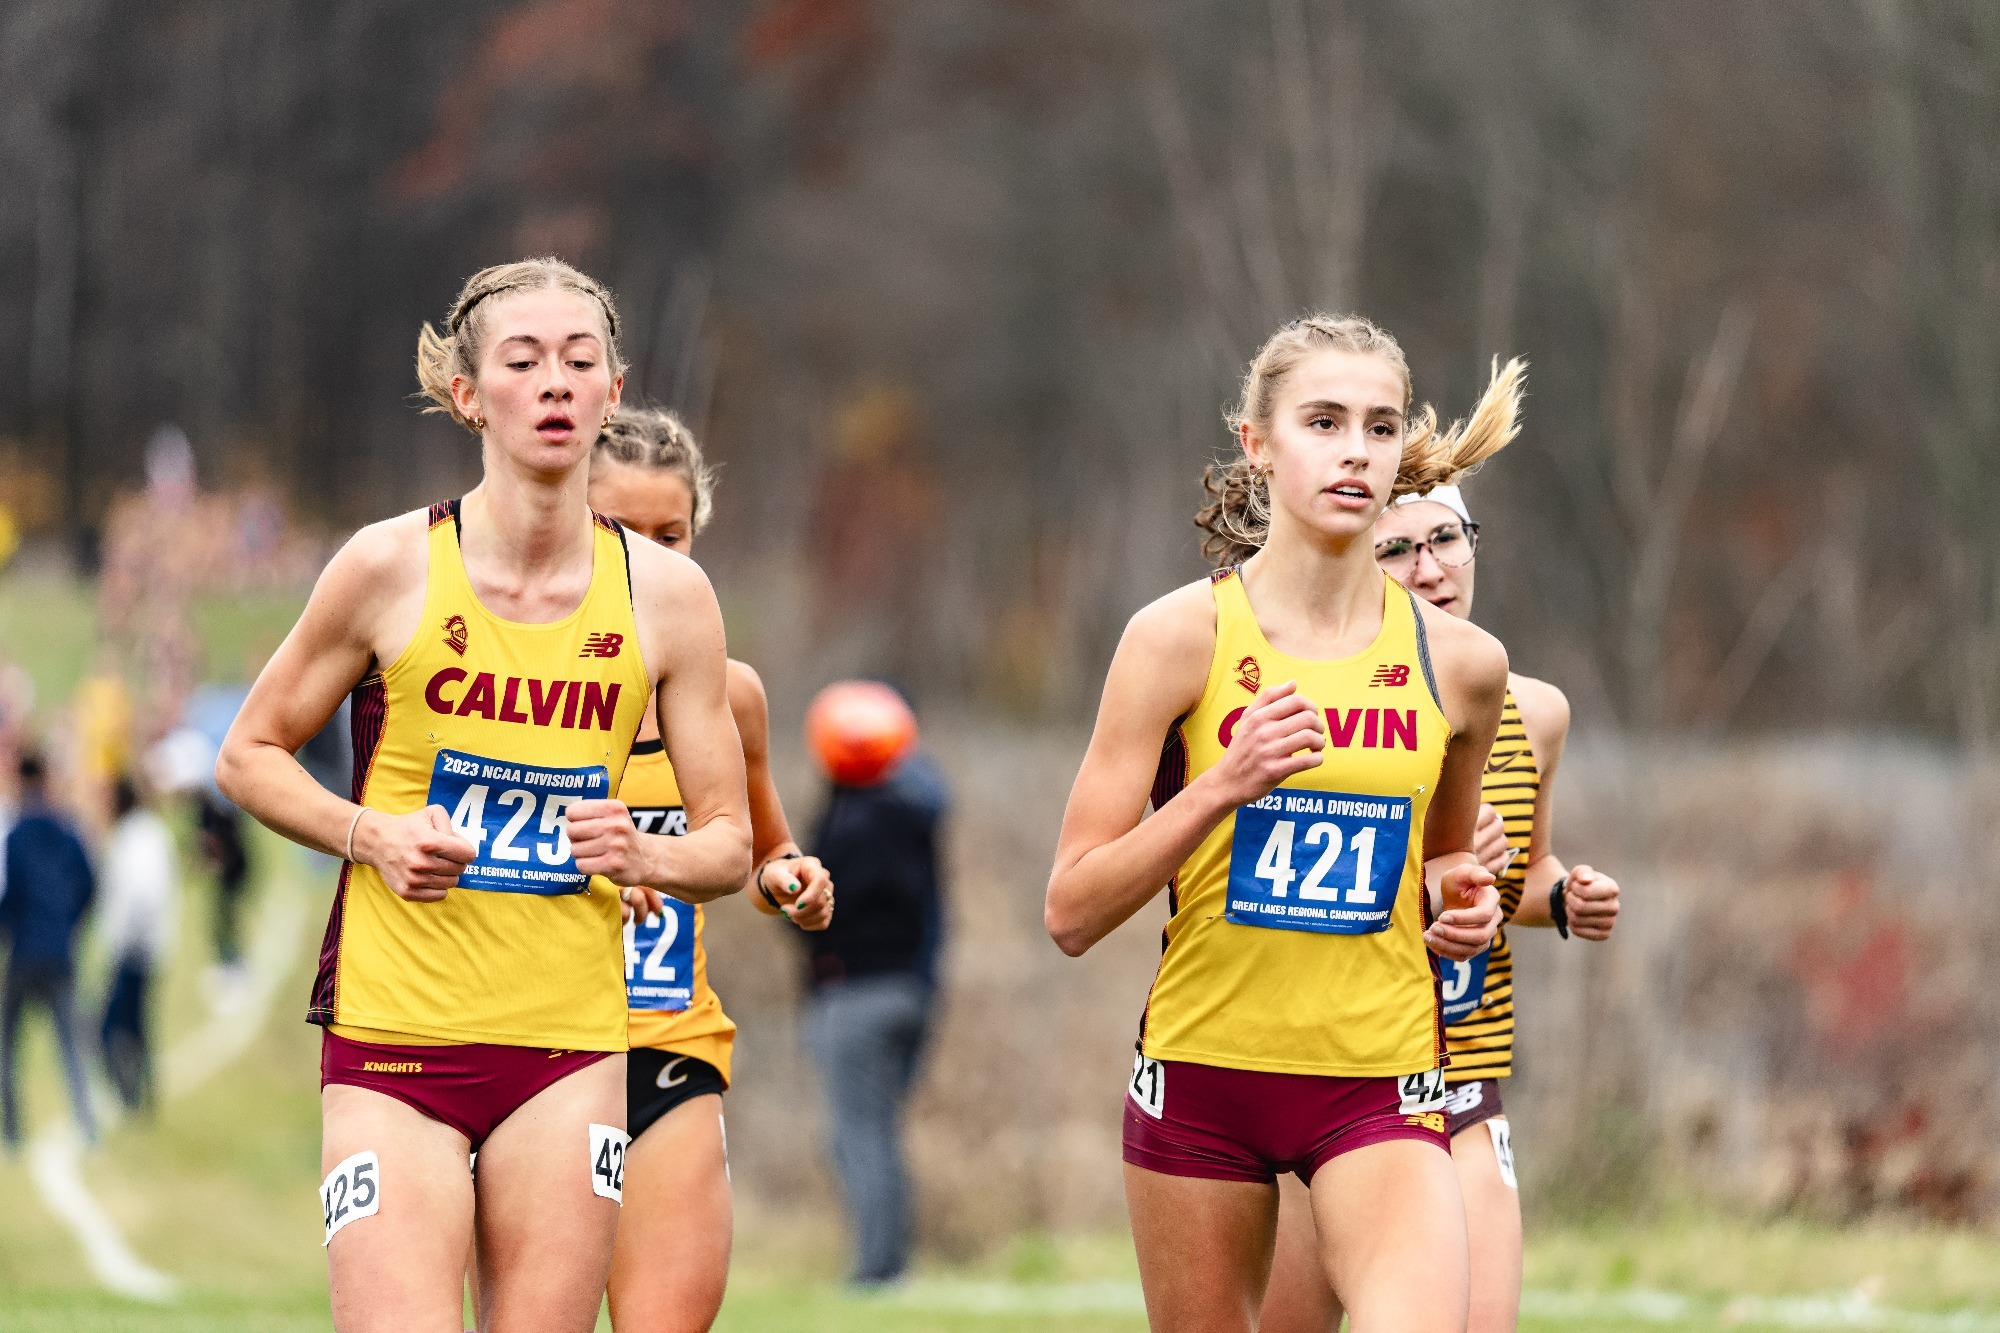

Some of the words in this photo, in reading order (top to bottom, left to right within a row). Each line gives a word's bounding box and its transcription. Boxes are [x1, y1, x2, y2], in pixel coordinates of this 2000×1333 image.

[579, 633, 624, 658] NB
[1368, 665, 1410, 688] NB
[424, 667, 622, 731] CALVIN
[1217, 706, 1417, 751] CVIN
[443, 757, 479, 777] 2023
[482, 765, 521, 783] NCAA
[524, 771, 584, 788] DIVISION
[587, 774, 601, 788] III
[1286, 797, 1324, 814] NCAA
[1327, 800, 1387, 819] DIVISION
[1390, 804, 1404, 820] III
[450, 783, 583, 866] 425
[481, 865, 520, 879] REGIONAL
[522, 870, 587, 883] CHAMPIONSHIPS
[1254, 820, 1377, 904] 421
[1232, 900, 1258, 912] GREAT
[1260, 903, 1286, 915] LAKES
[1288, 906, 1328, 919] REGIONAL
[1330, 910, 1389, 922] CHAMPIONSHIPS
[363, 1061, 422, 1073] KNIGHTS
[325, 1163, 376, 1230] 425
